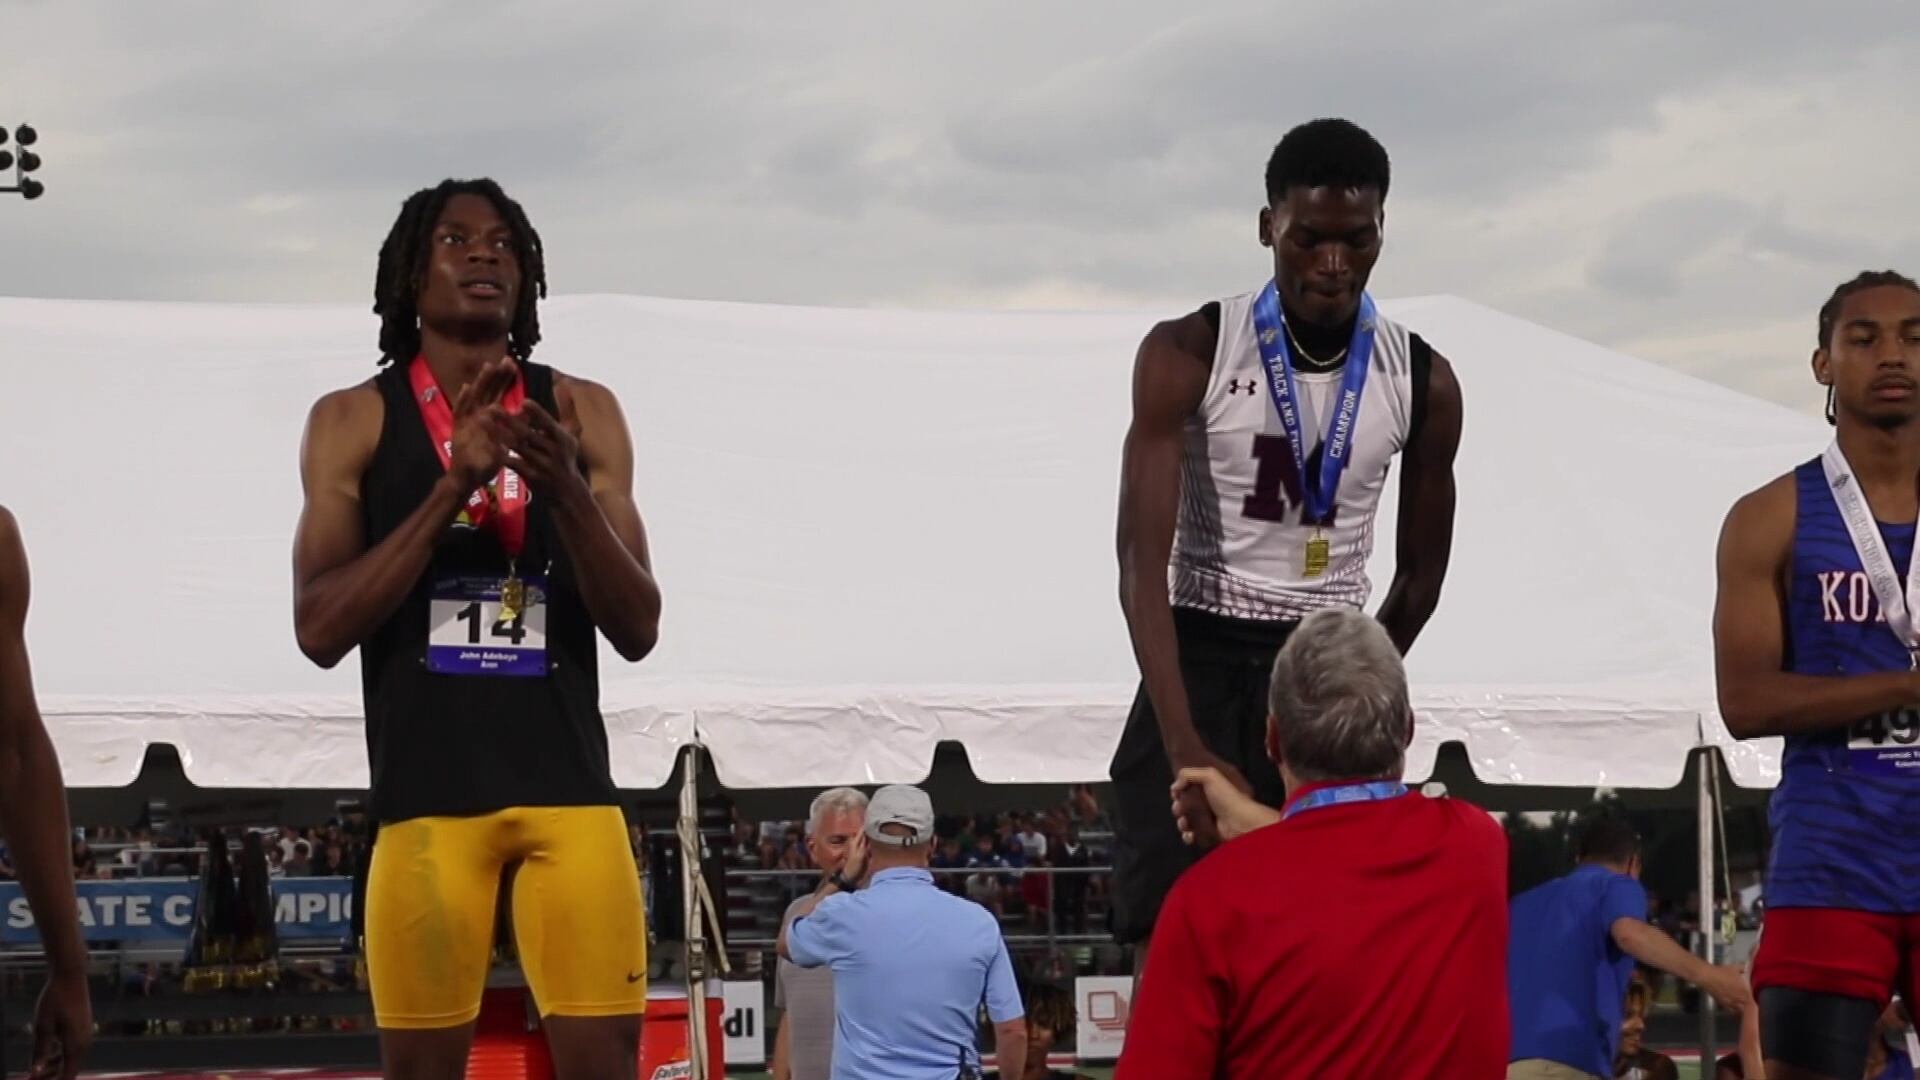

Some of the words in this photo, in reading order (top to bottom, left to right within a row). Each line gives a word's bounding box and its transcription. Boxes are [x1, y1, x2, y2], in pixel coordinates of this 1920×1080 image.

[1268, 354, 1289, 398] TRACK
[1280, 401, 1295, 426] AND
[1329, 389, 1357, 459] CHAMPION
[1241, 434, 1352, 528] M
[457, 601, 527, 645] 14
[460, 652, 480, 660] John
[1849, 706, 1920, 746] 49
